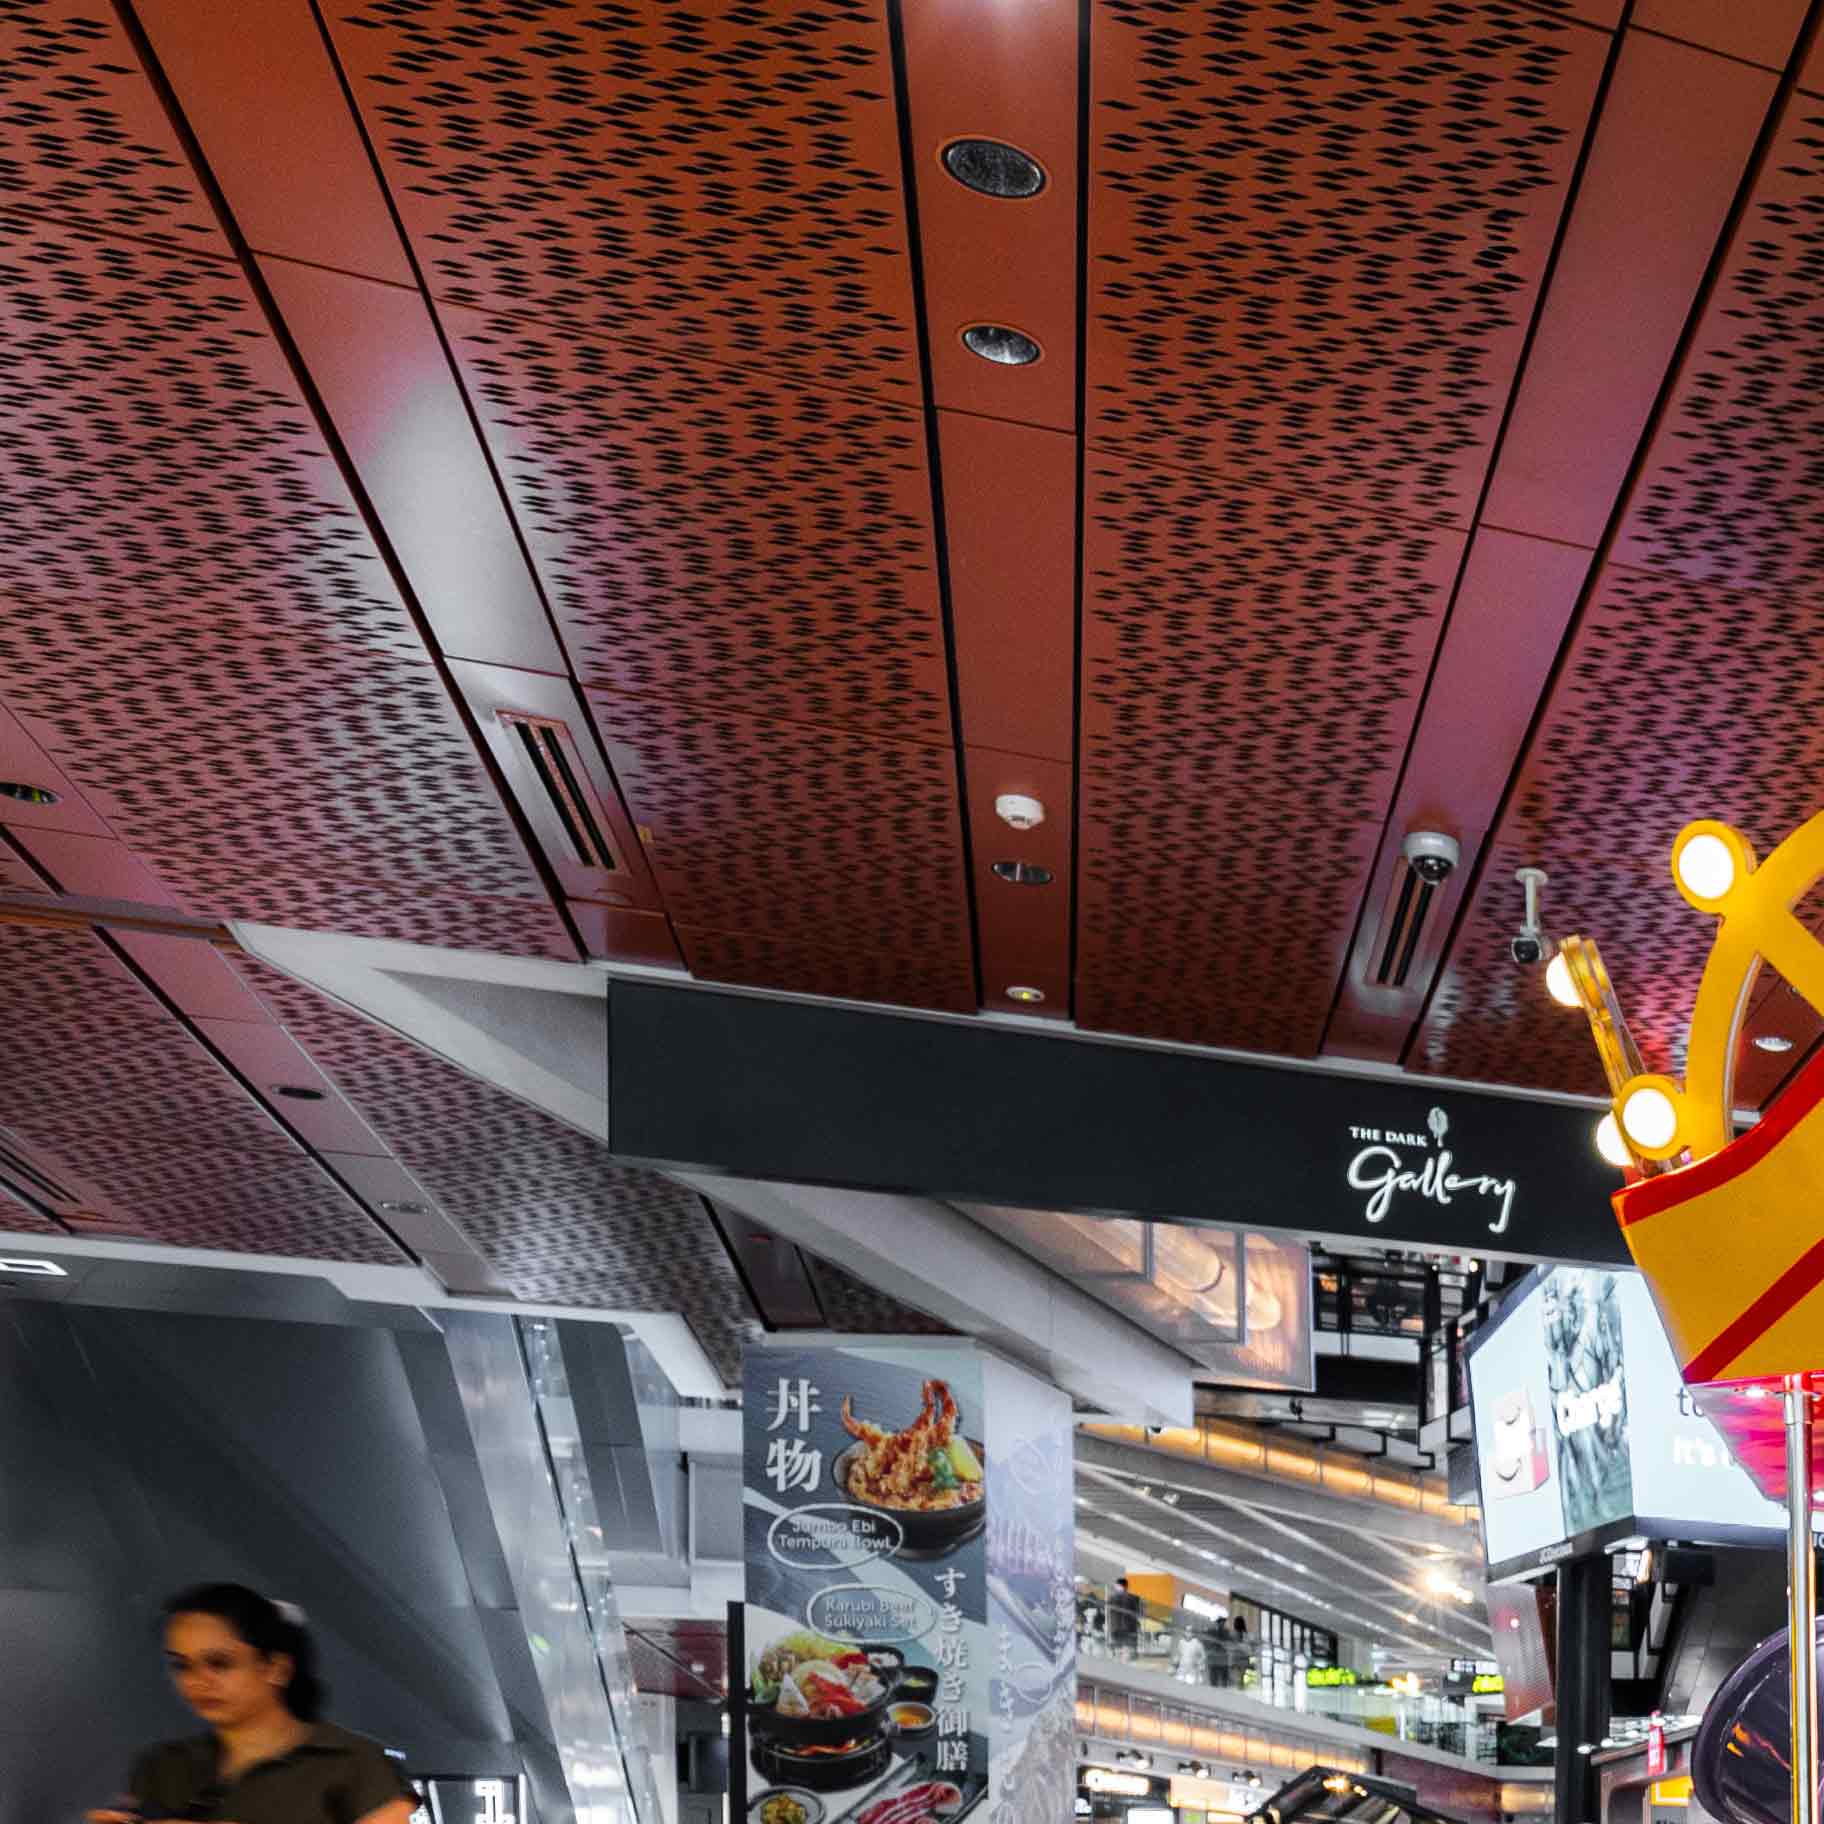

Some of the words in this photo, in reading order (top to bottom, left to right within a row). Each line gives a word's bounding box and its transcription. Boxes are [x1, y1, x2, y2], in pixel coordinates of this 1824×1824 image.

[1349, 1125, 1382, 1142] THE
[1385, 1128, 1427, 1148] DARK
[852, 1519, 877, 1533] Ebi
